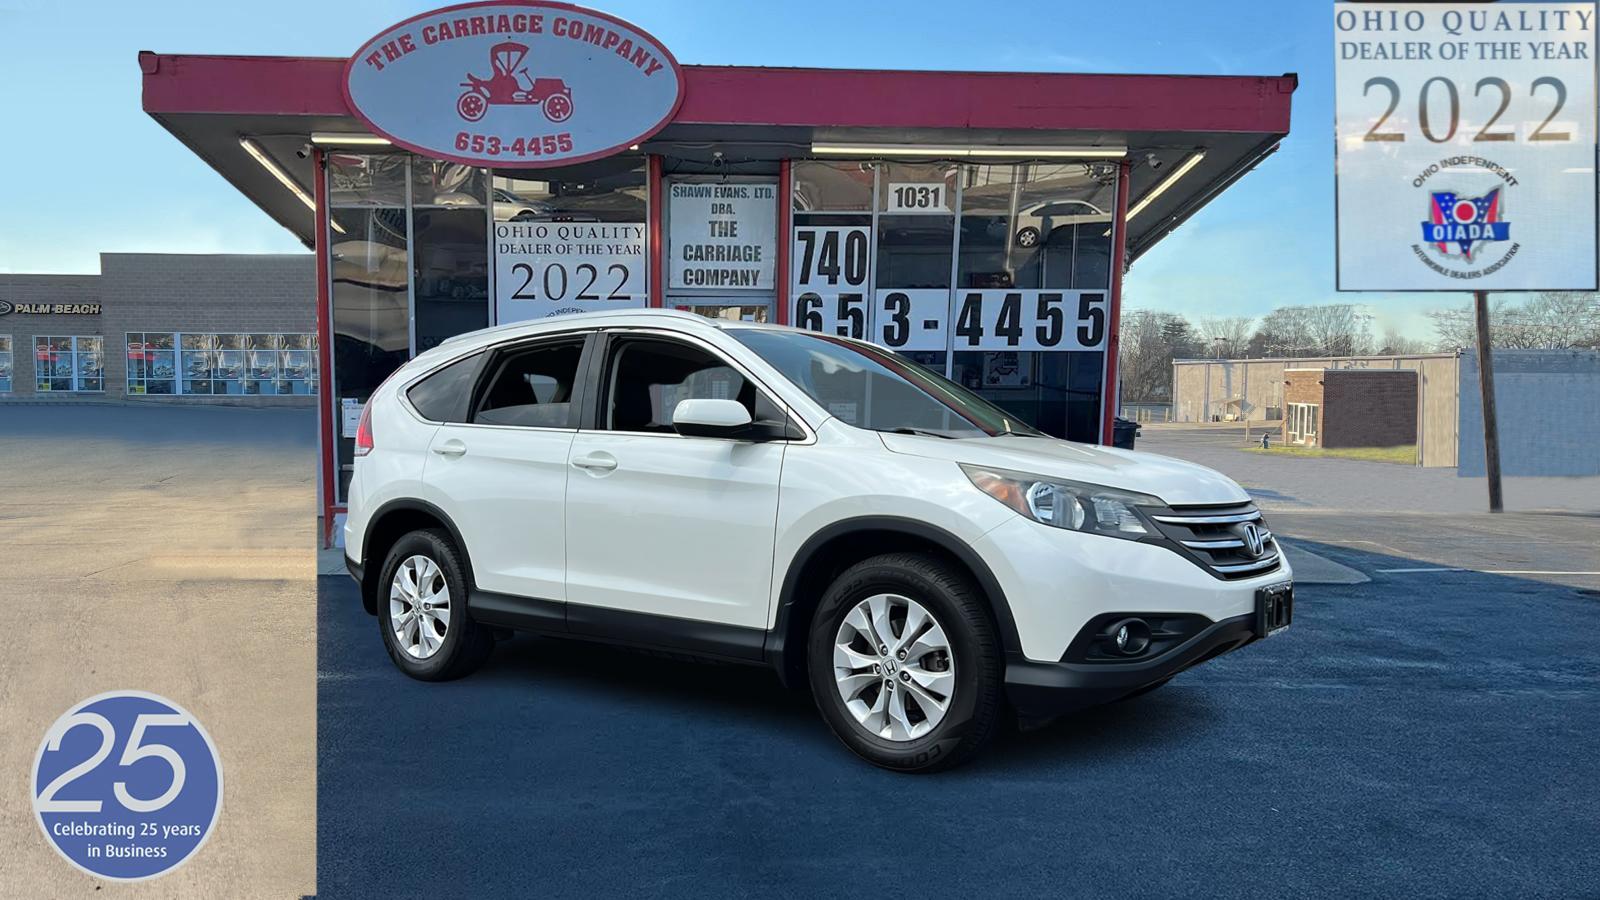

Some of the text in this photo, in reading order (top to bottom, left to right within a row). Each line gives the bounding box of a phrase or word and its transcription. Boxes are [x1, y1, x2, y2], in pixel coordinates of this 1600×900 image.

[1336, 10, 1592, 35] OHIO QUALITY
[366, 14, 663, 77] THE CARRIAGE COMPANY
[1340, 41, 1589, 60] DEALER OF THE YEAR
[1363, 76, 1571, 143] 2022
[455, 132, 573, 156] 653-4455
[1412, 155, 1519, 188] OHIO INDEPENDENT
[672, 186, 712, 199] SHAWN
[754, 187, 775, 199] LTD.
[895, 187, 940, 208] 1031
[711, 203, 735, 215] DBA.
[497, 225, 644, 242] OHIO QUALITY
[708, 220, 738, 237] THE
[1432, 224, 1495, 240] OIADA
[499, 243, 641, 255] DEALER OF THE YEAR
[683, 244, 762, 262] CARRIAGE
[797, 230, 867, 286] 740
[1411, 242, 1521, 280] AUTOMOBILE DEALERS ASSOCIATION
[511, 263, 631, 300] 2022
[683, 268, 760, 286] COMPANY
[15, 304, 100, 314] PALM BEACH
